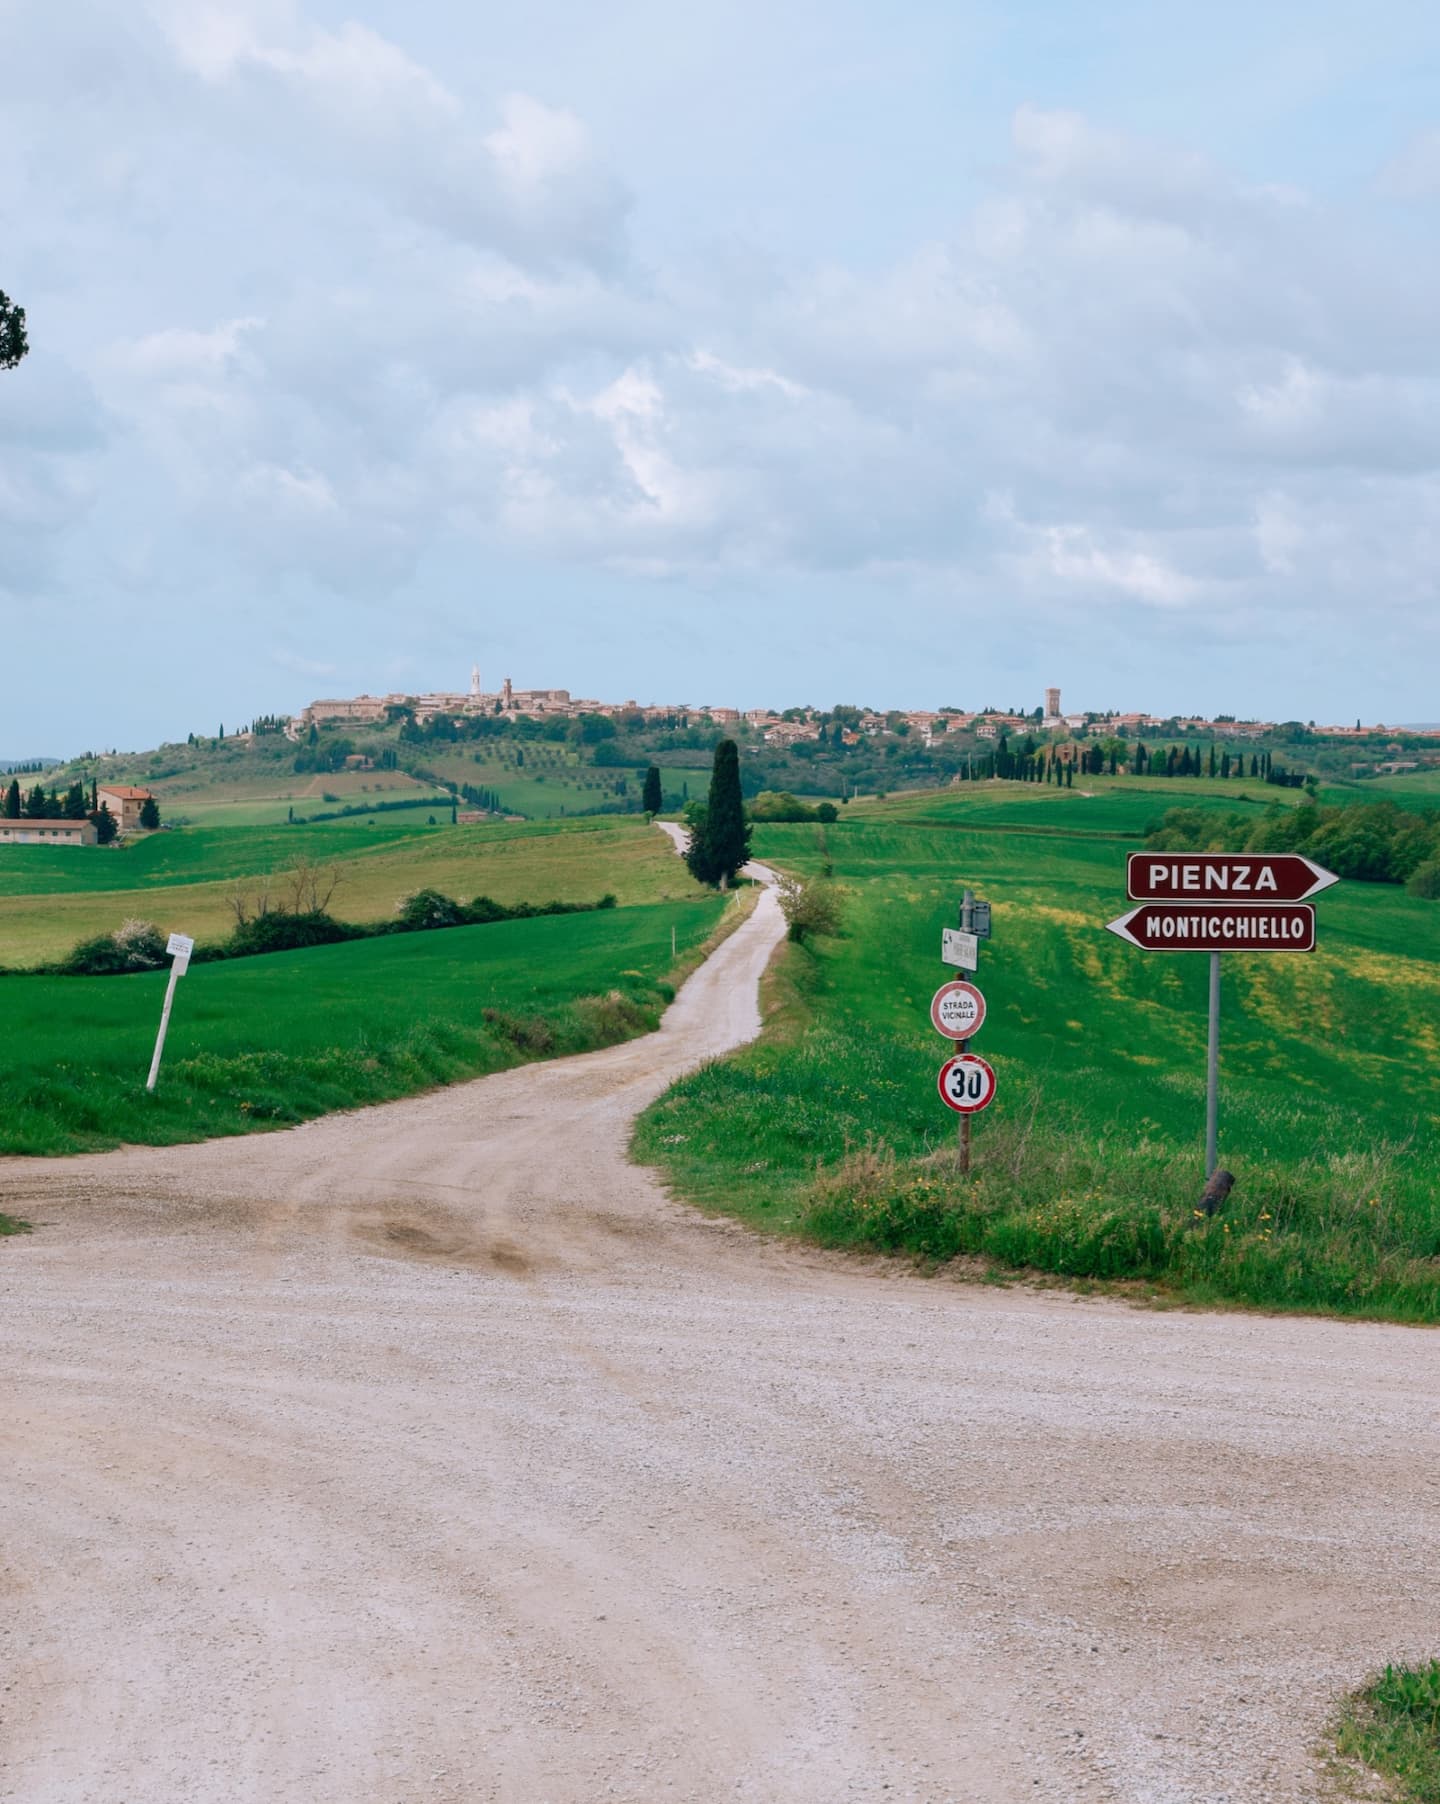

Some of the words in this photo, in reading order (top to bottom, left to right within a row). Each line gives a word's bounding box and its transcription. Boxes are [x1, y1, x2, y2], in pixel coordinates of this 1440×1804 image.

[1149, 864, 1278, 891] PIENZA
[1146, 916, 1304, 939] MONTICCHIELLO
[942, 1010, 976, 1020] VICINALE
[943, 1001, 974, 1010] STRADA
[951, 1067, 981, 1099] 30
